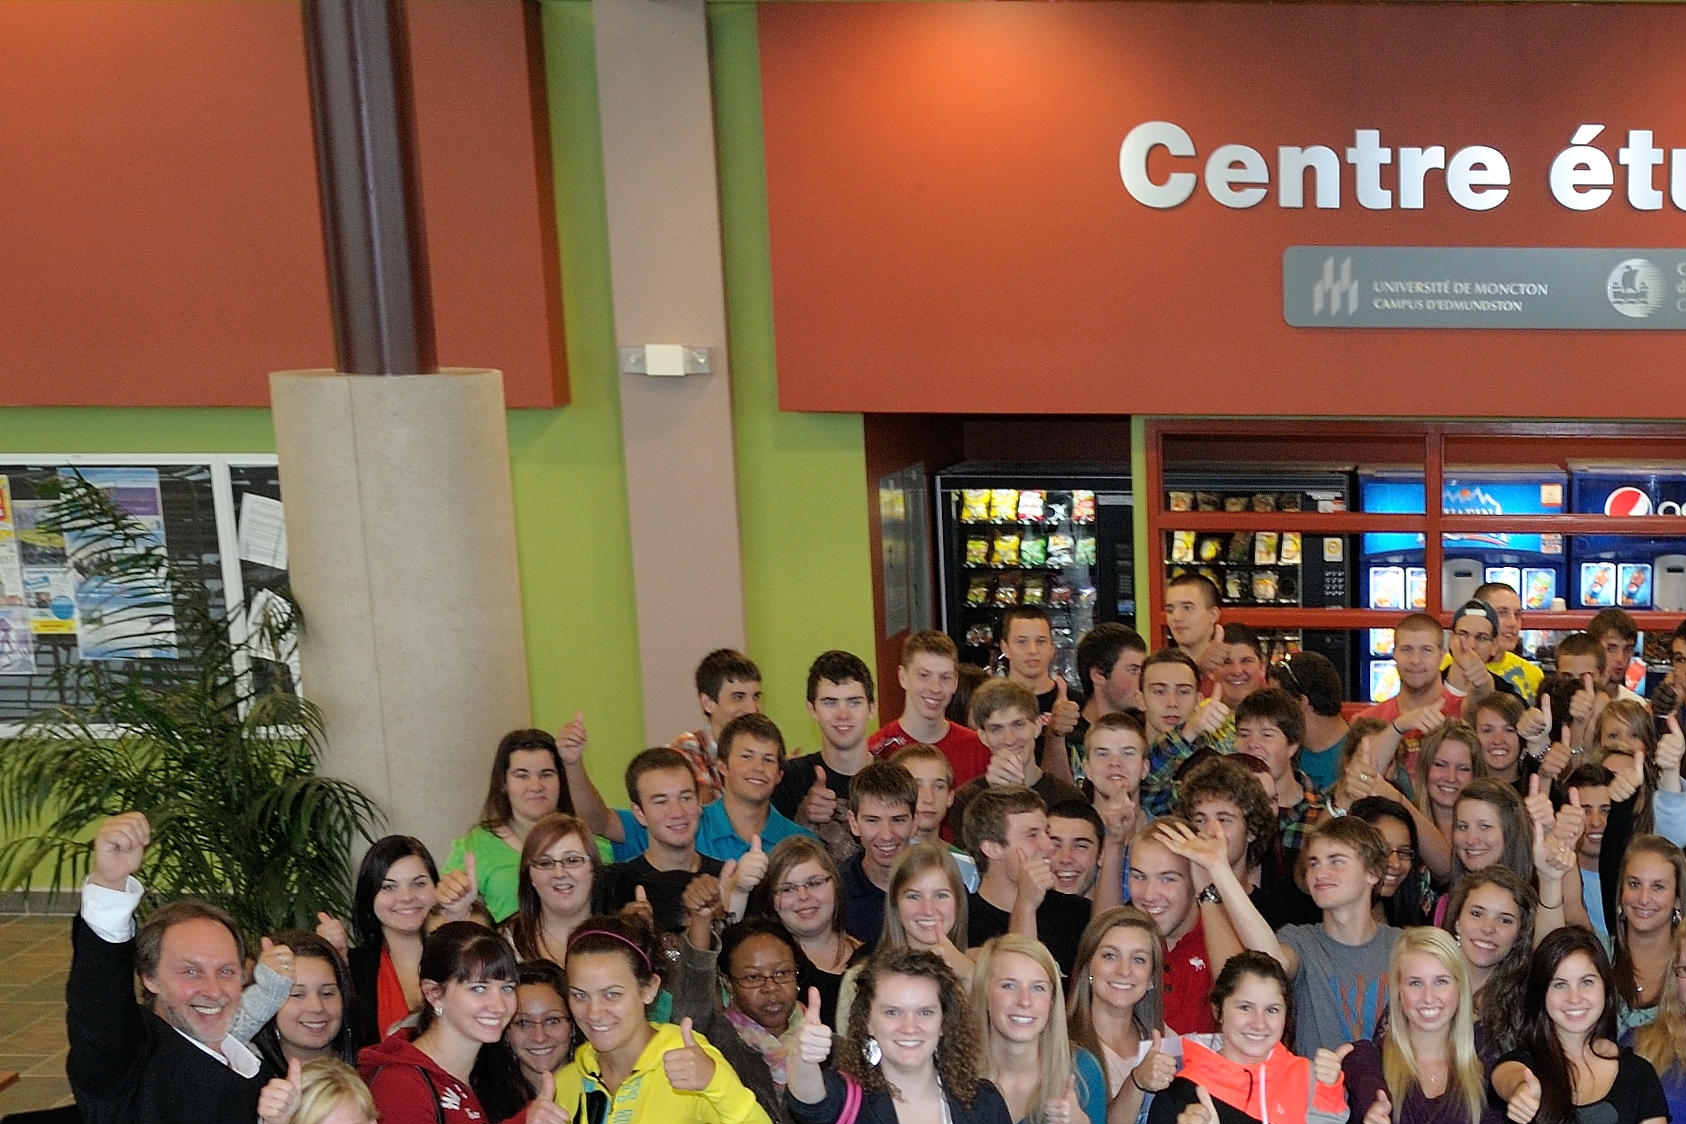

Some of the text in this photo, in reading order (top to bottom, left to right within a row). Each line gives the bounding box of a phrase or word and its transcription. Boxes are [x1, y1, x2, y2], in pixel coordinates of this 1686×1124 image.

[1119, 121, 1511, 210] Centre
[1373, 280, 1548, 296] UNIVERSITÉ DE MONCTON
[1373, 298, 1523, 312] CAMPUS D'EDMUNDSTON
